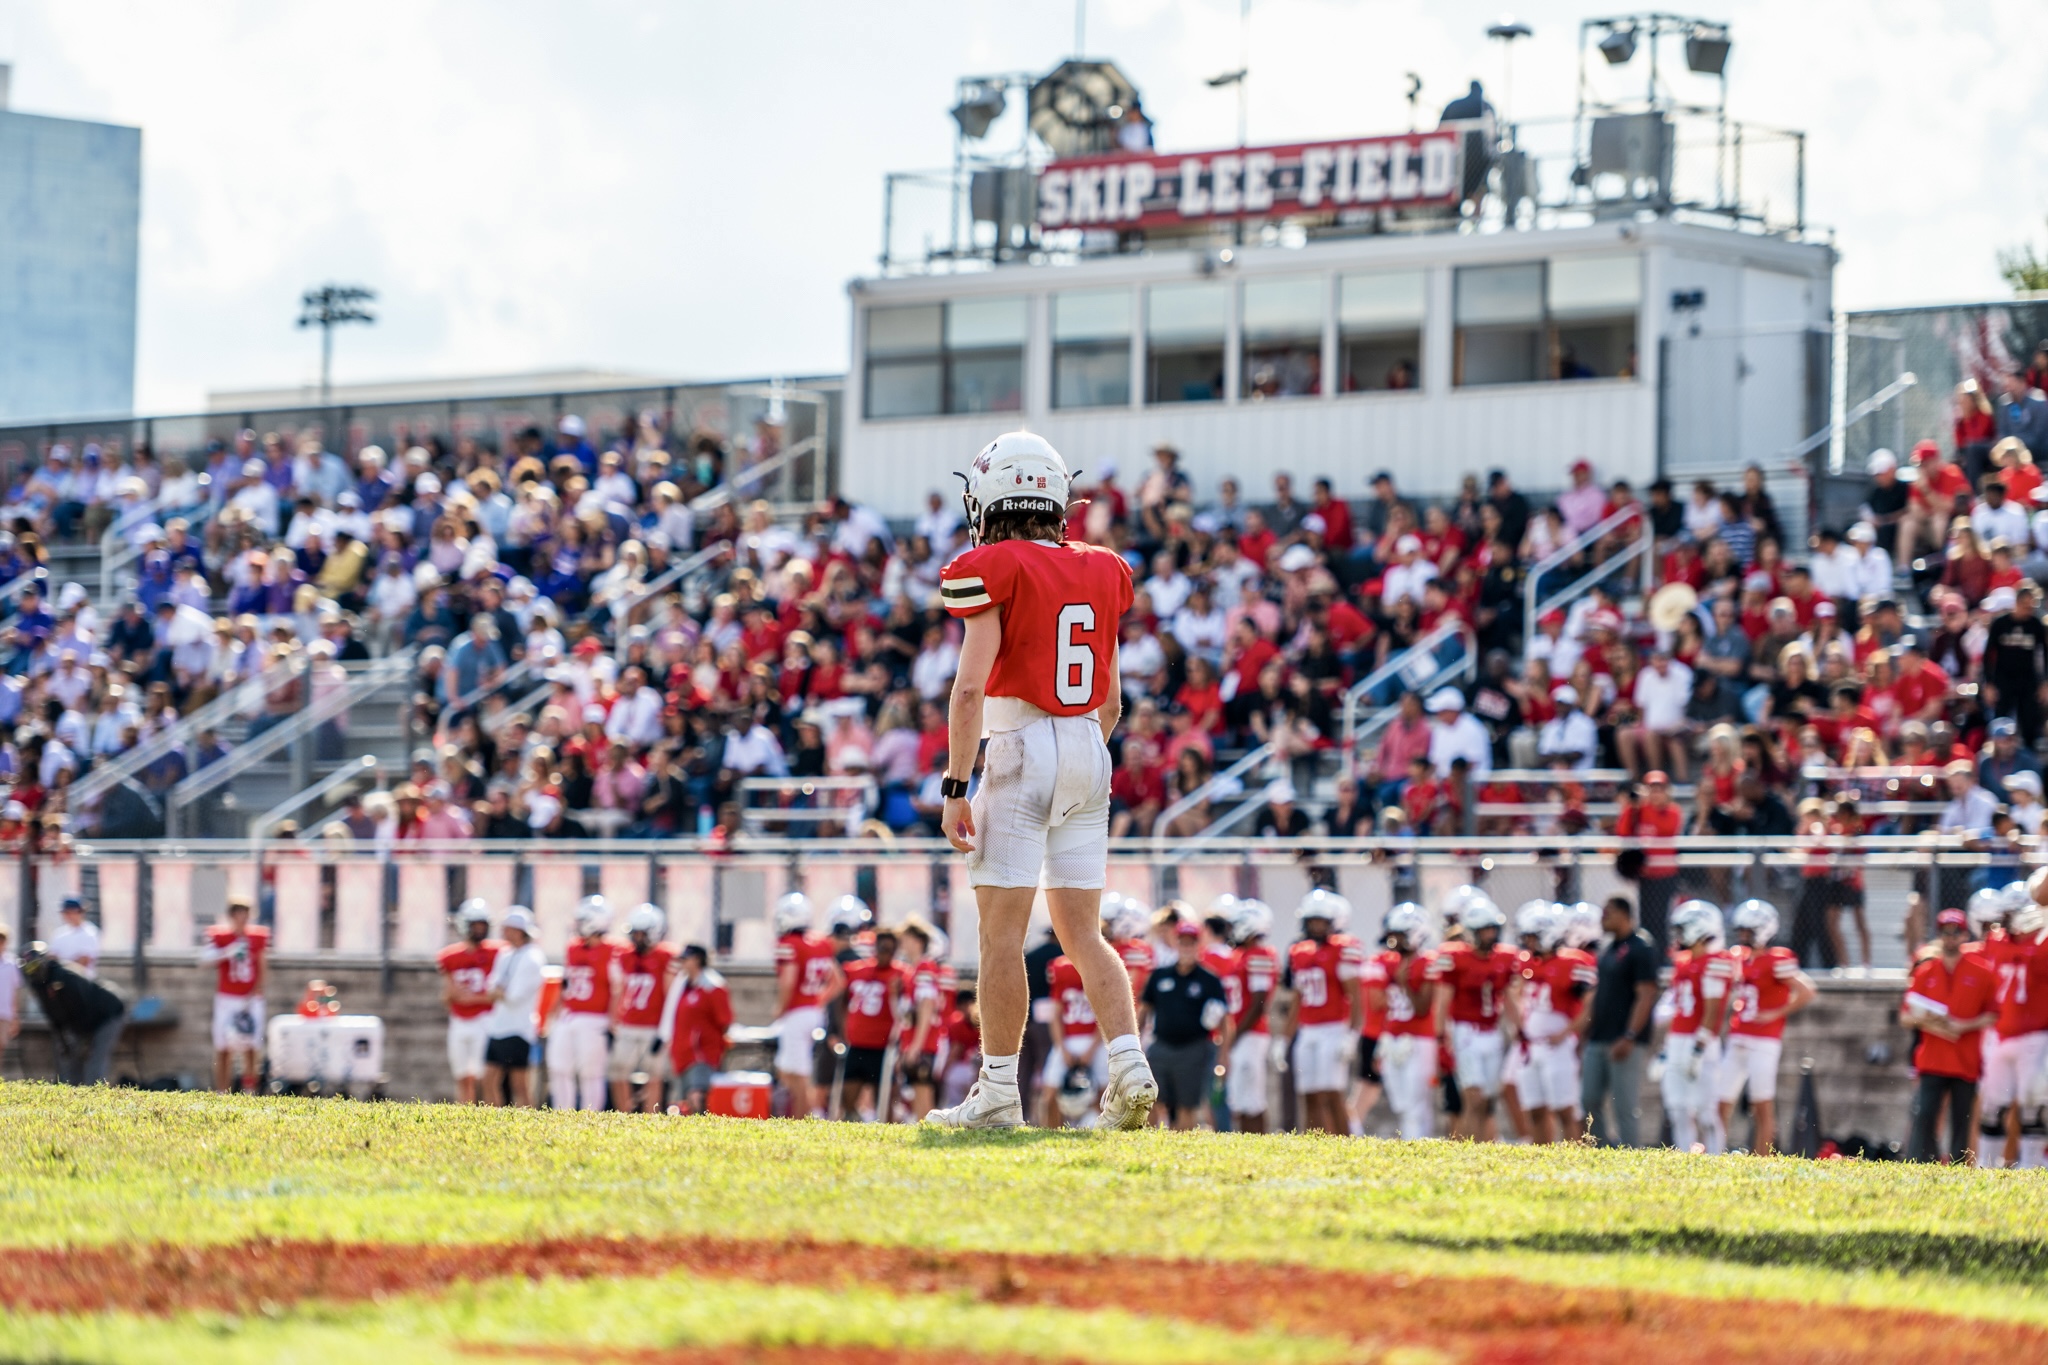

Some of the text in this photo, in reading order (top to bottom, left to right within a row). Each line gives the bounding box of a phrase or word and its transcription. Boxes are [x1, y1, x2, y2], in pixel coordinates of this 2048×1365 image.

[1038, 138, 1455, 226] SKIP LEE FIELD
[1015, 475, 1022, 485] 6
[1003, 499, 1053, 512] Riddell
[1055, 603, 1095, 707] 6
[1996, 962, 2027, 1005] 71
